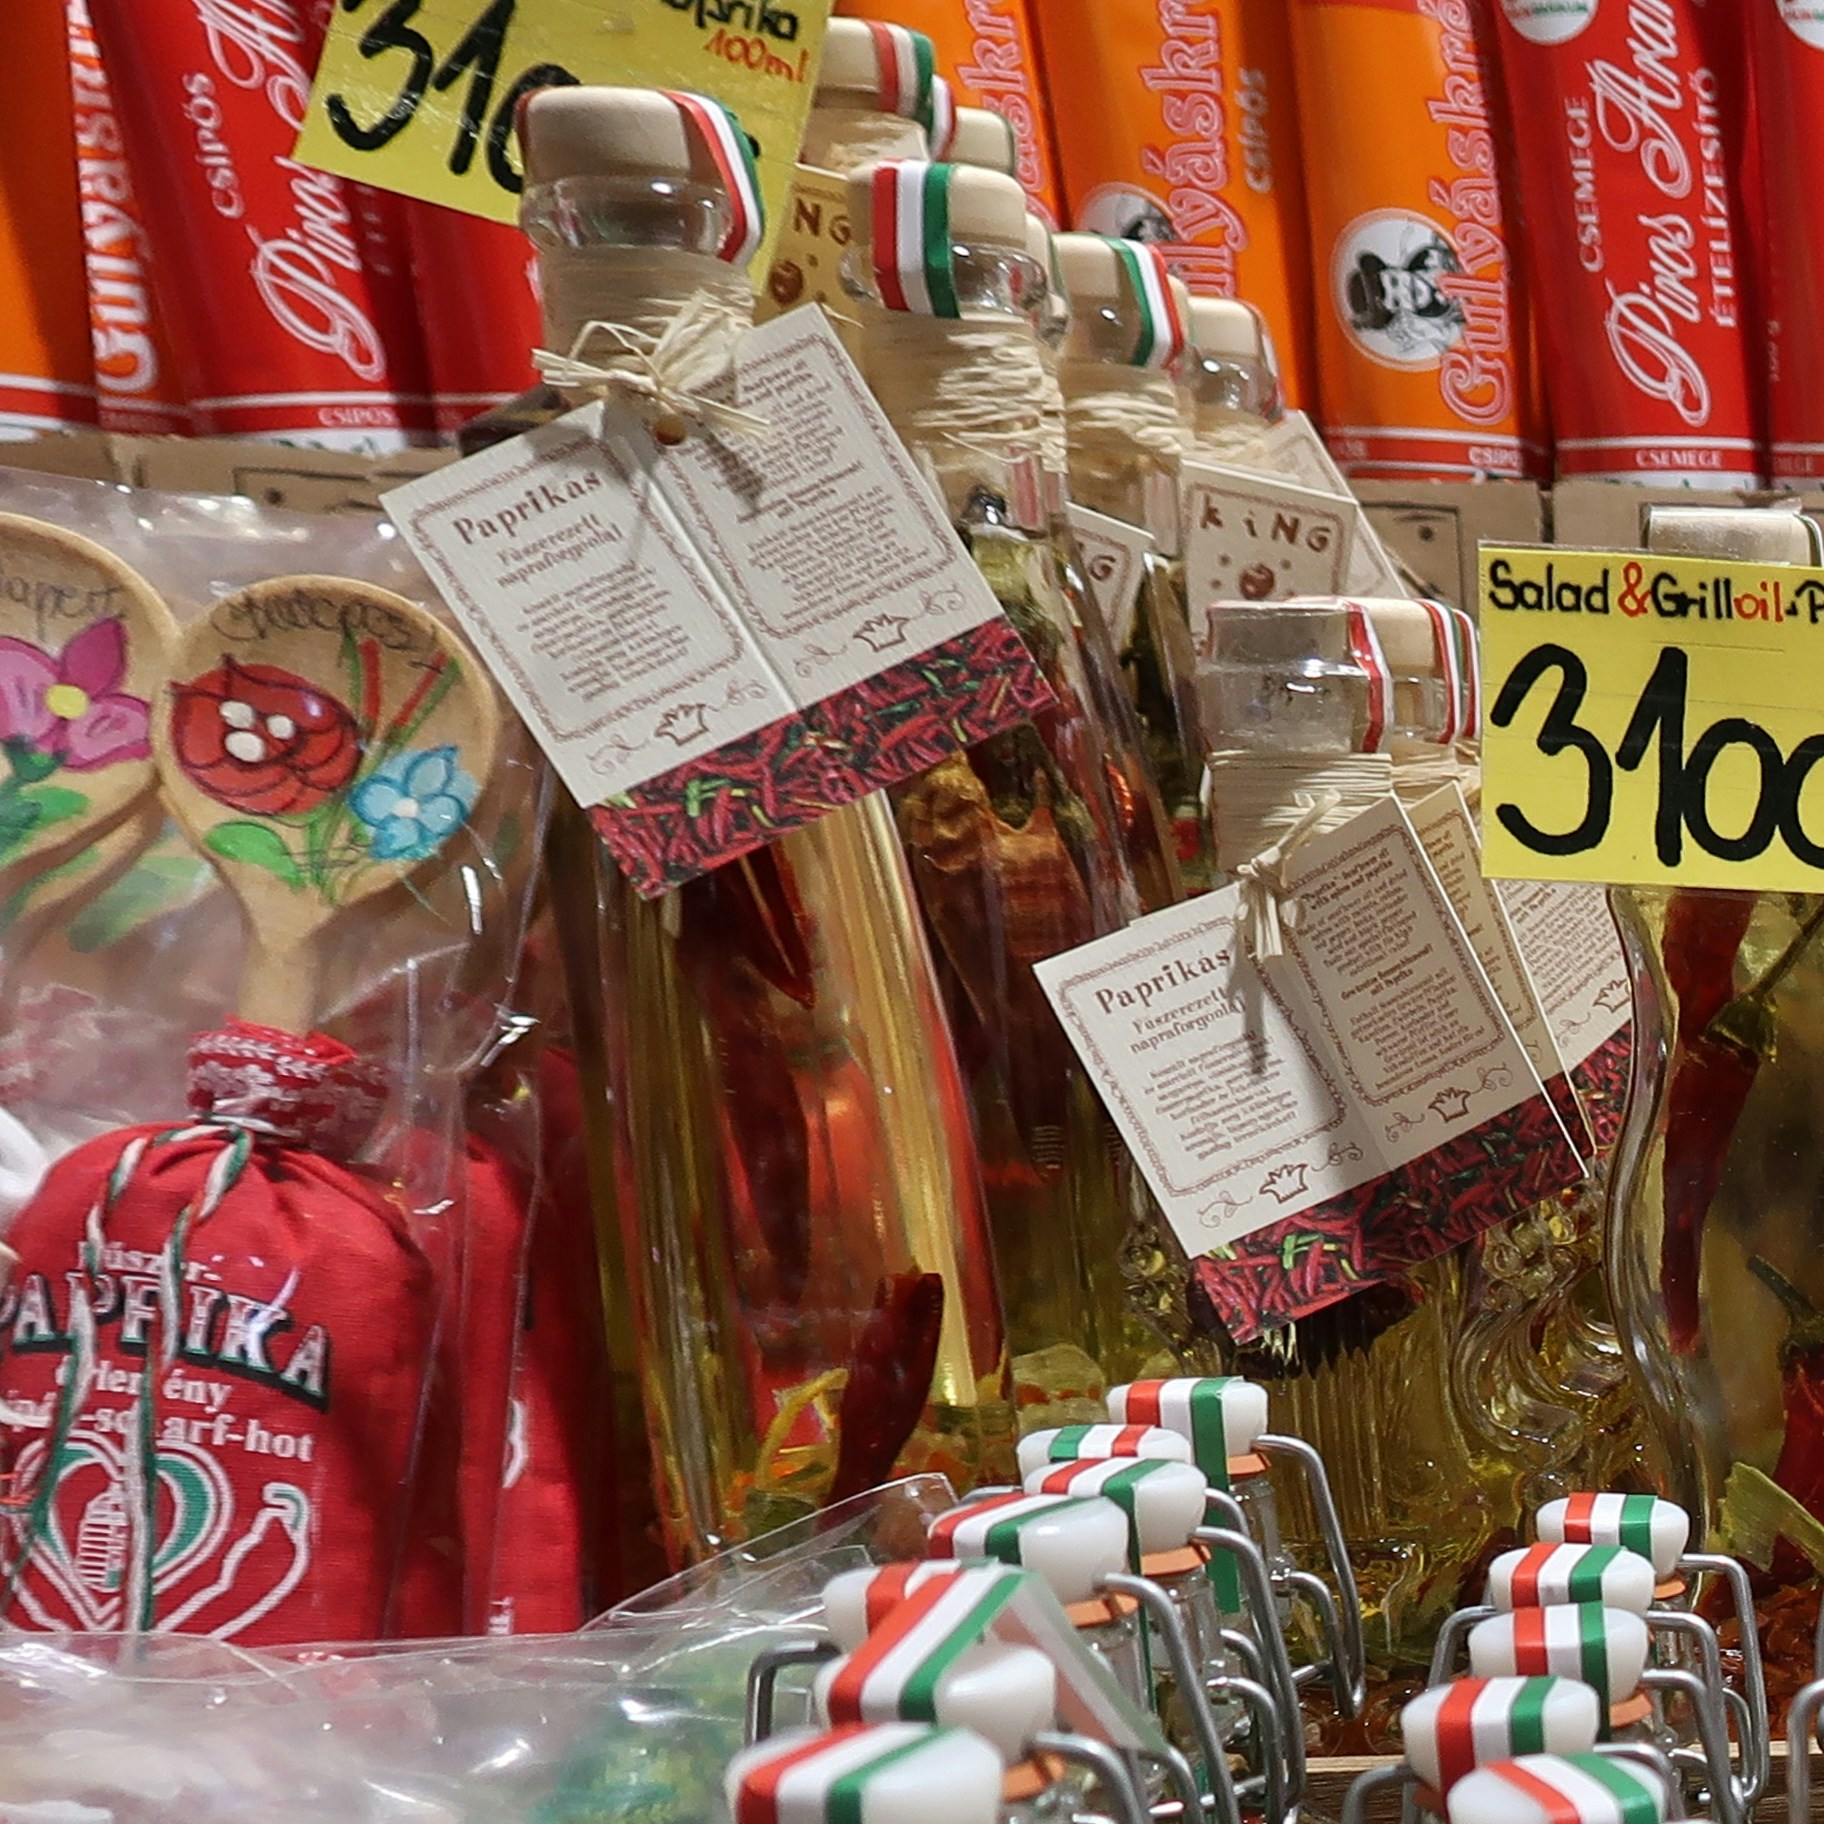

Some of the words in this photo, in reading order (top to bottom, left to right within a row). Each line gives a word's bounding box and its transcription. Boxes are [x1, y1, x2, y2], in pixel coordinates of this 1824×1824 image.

[706, 30, 808, 82] 100ml
[1428, 0, 1512, 425] Gulyáskré
[1564, 96, 1606, 273] CSEMEGE
[1604, 212, 1711, 427] Piros
[1636, 449, 1723, 468] CSEMEGE
[1489, 559, 1610, 613] Salad
